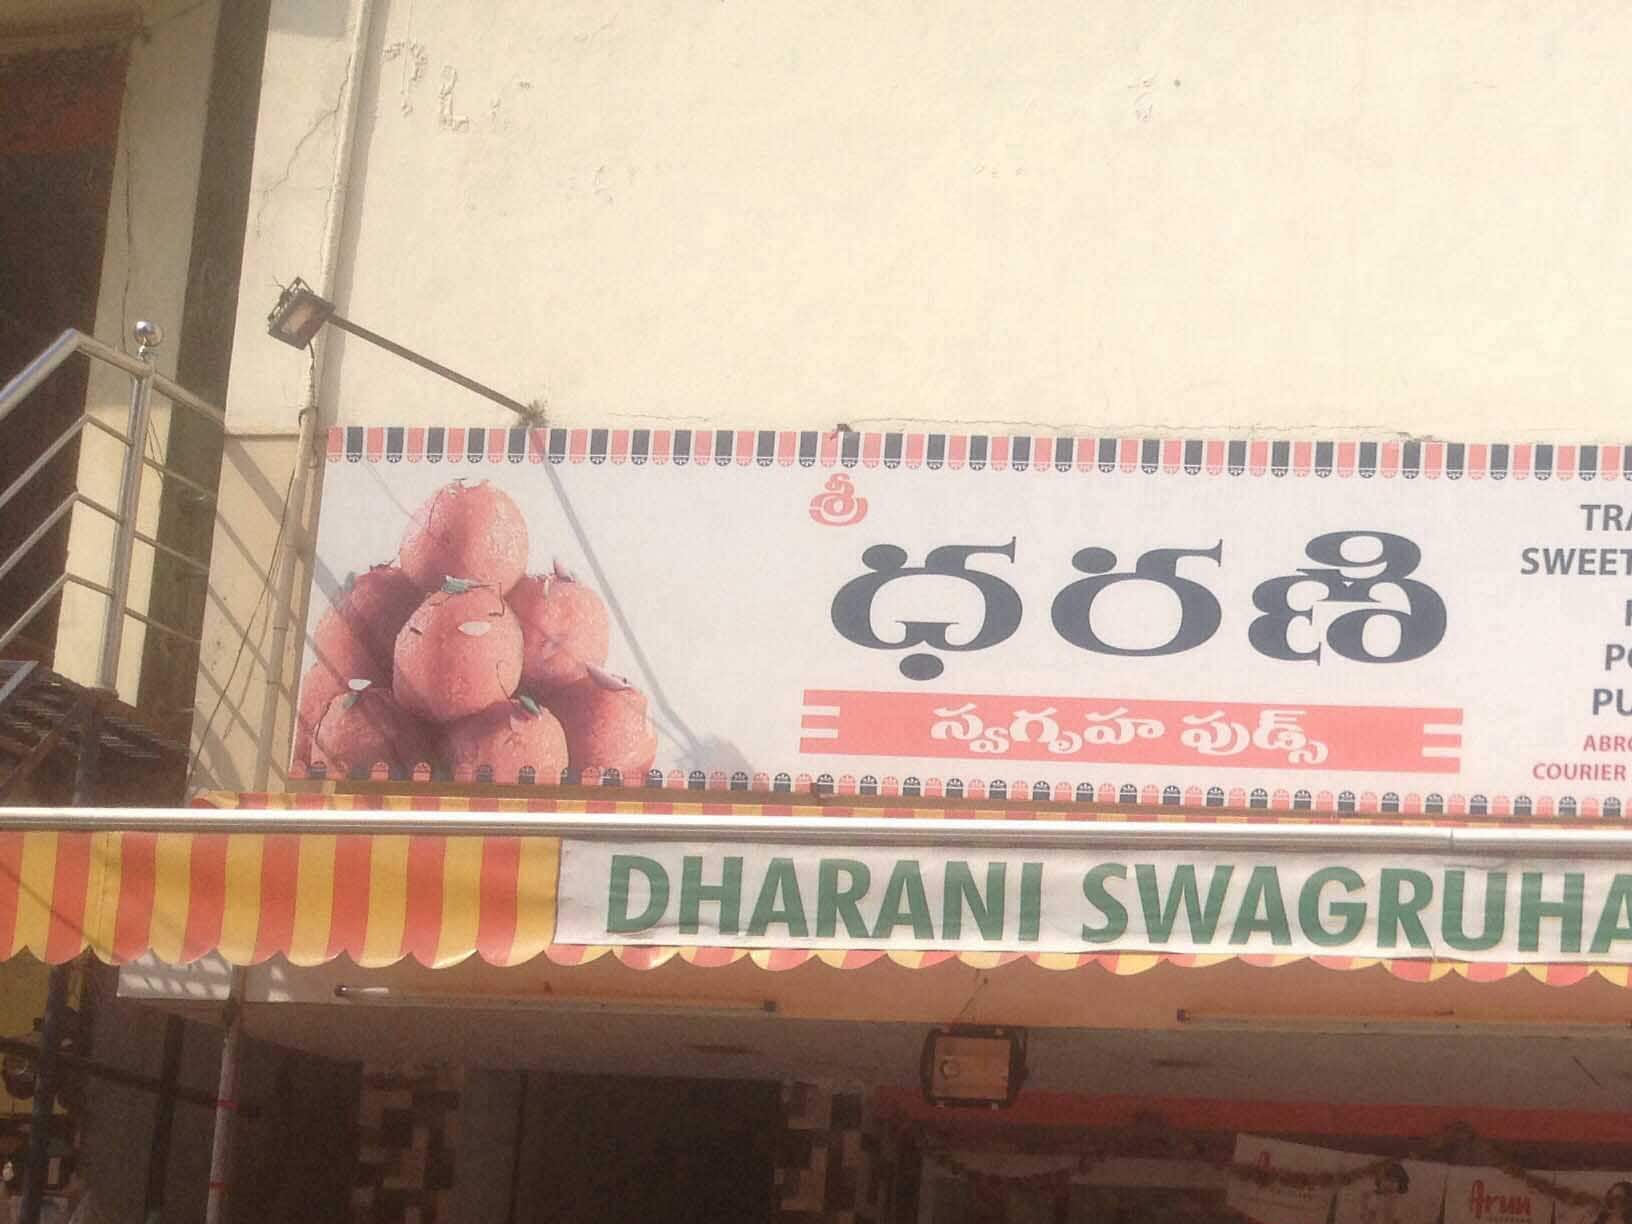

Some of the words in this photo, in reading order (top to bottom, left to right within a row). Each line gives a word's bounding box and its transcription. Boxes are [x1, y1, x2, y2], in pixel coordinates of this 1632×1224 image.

[809, 472, 868, 527] శ్రీ
[830, 531, 1448, 681] ధరణి
[1532, 763, 1626, 782] COURIER
[605, 854, 1045, 942] DHARANI
